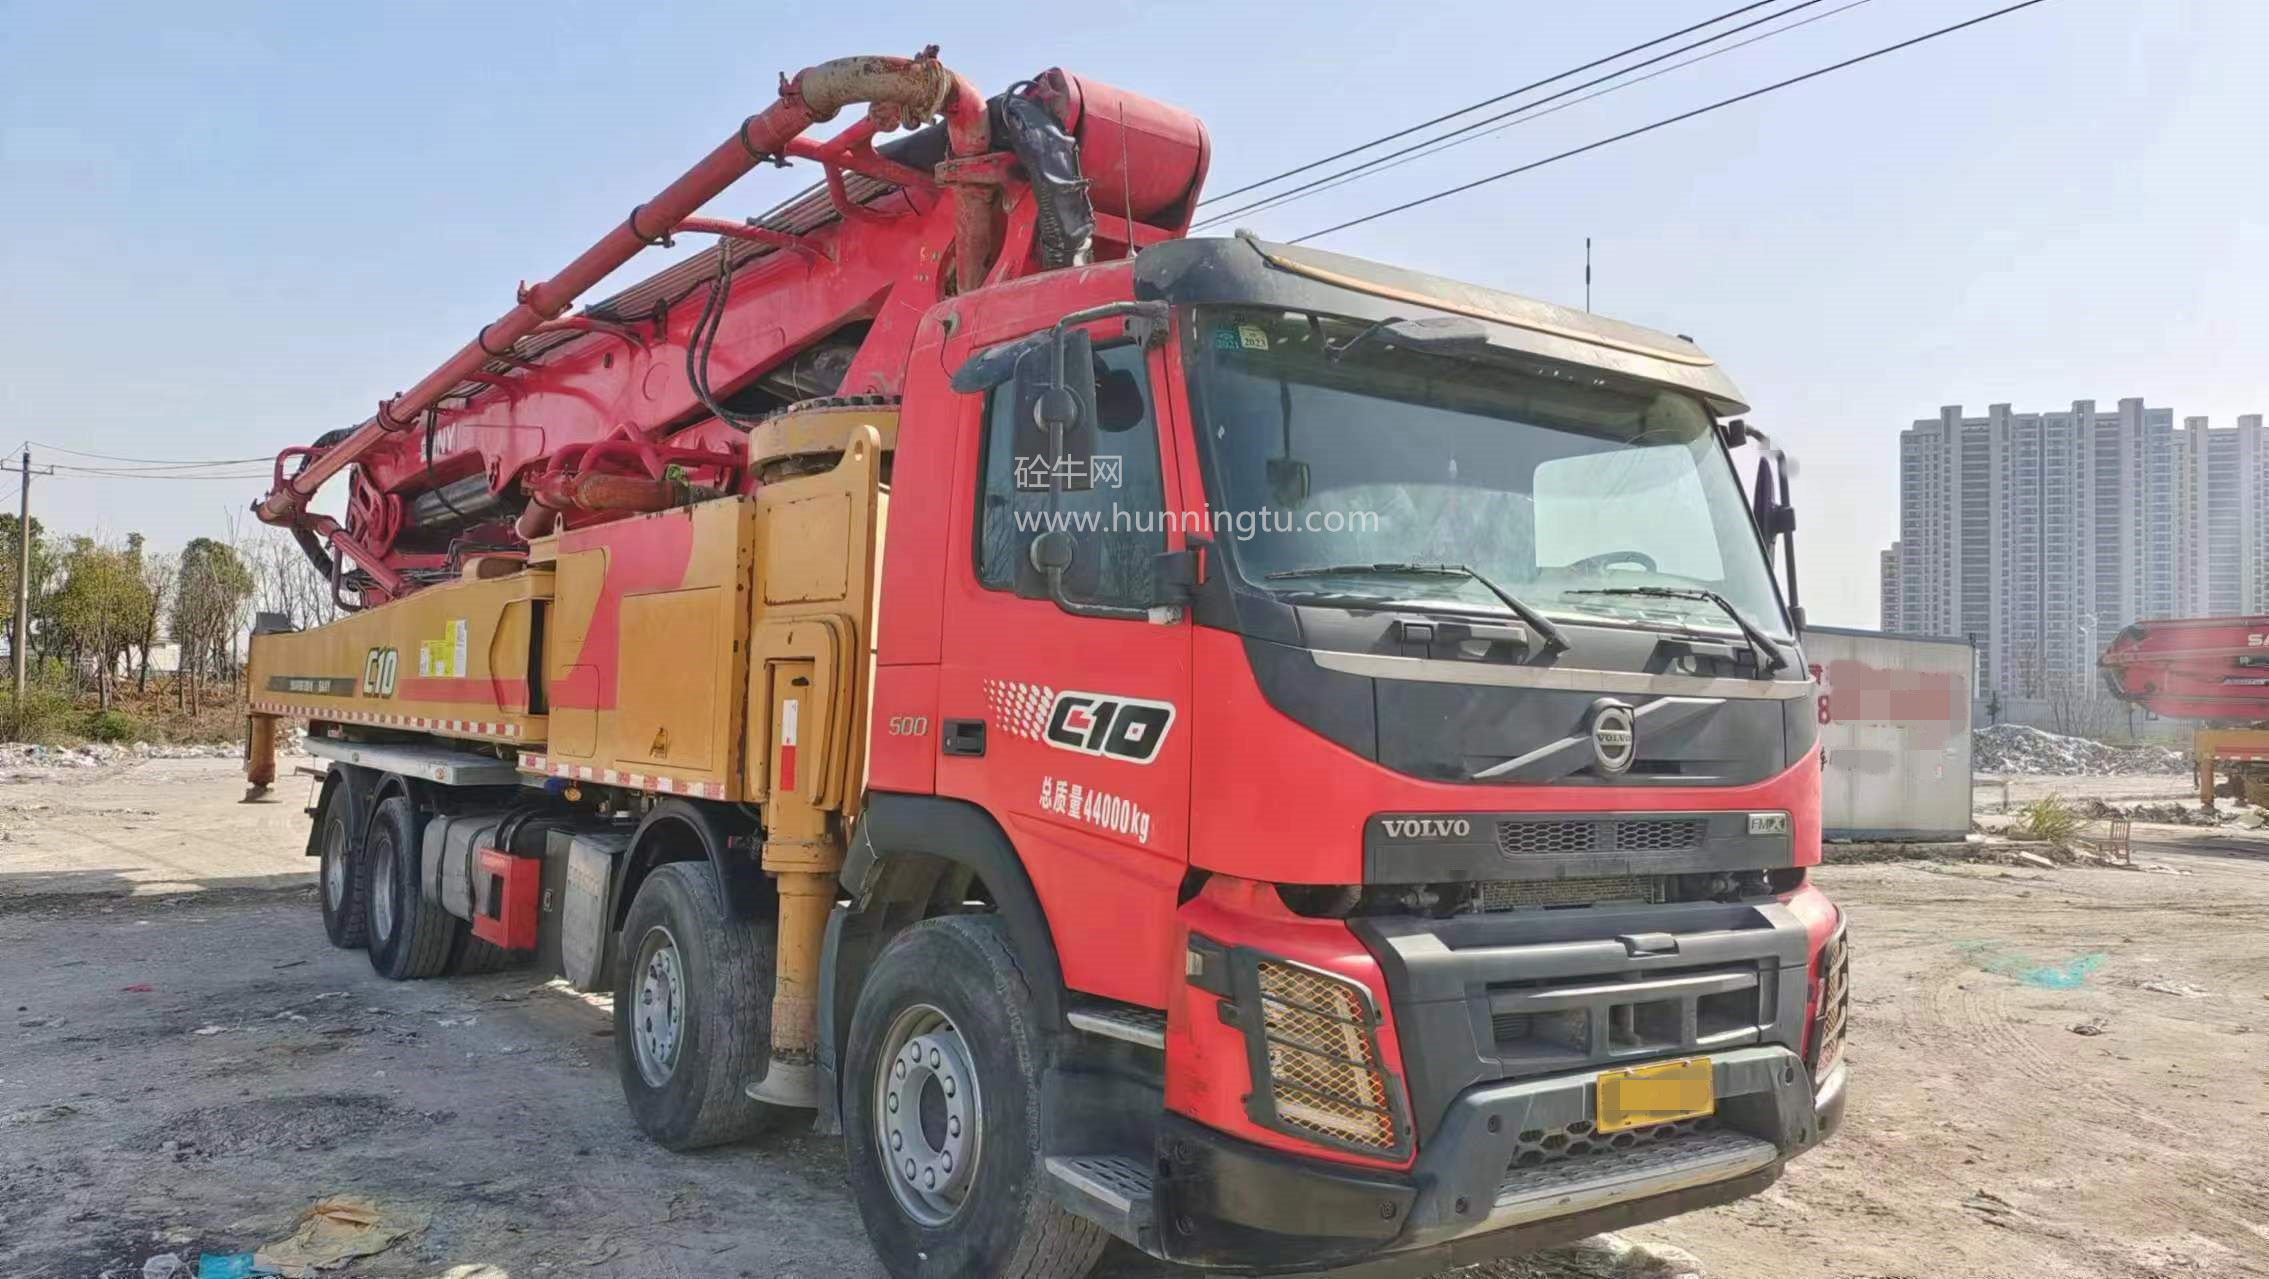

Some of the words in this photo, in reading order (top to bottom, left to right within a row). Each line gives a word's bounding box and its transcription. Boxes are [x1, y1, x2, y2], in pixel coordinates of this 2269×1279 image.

[888, 716, 928, 737] 500
[1044, 693, 1174, 763] C10
[1597, 733, 1631, 743] VOLVO
[1039, 776, 1151, 844] 总质量44000kg
[1381, 818, 1470, 838] VOLVO
